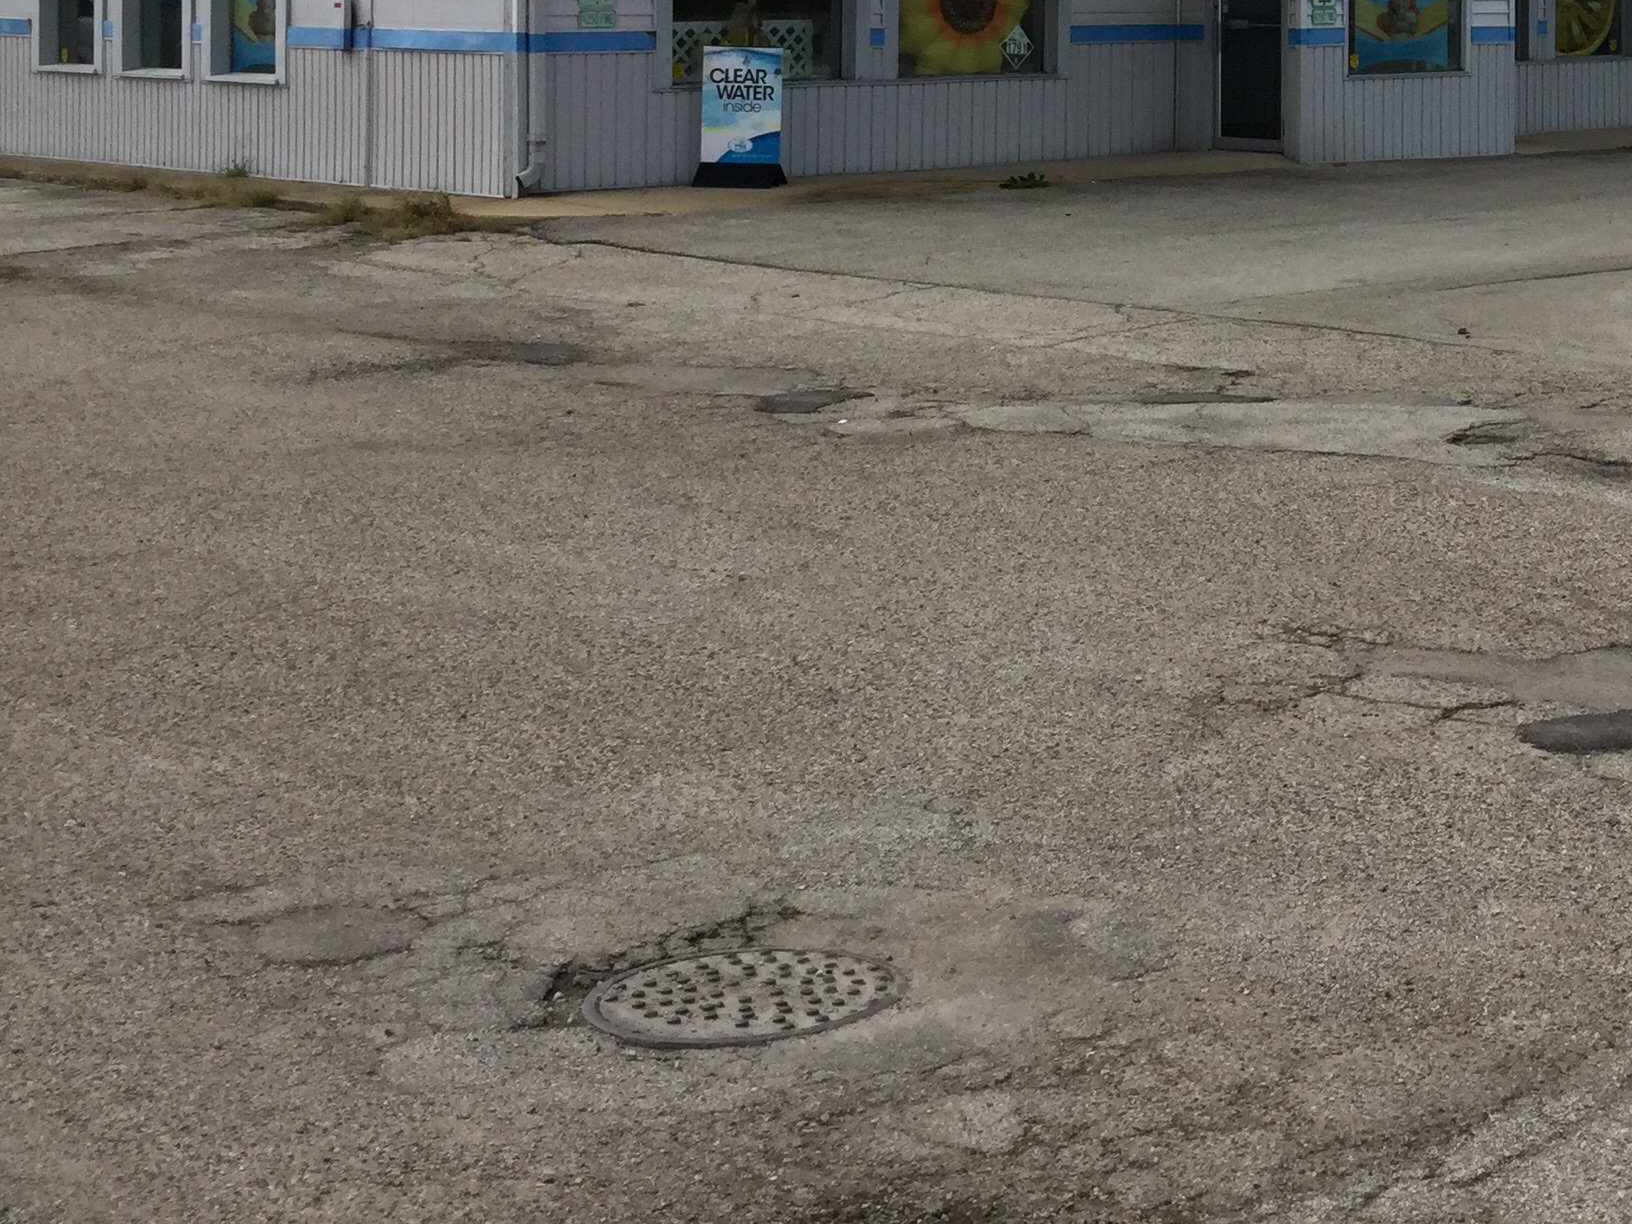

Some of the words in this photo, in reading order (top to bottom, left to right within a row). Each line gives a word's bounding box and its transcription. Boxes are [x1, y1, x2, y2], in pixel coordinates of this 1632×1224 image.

[709, 67, 768, 85] CLEAR
[716, 84, 775, 102] WATER
[722, 101, 762, 113] inside
